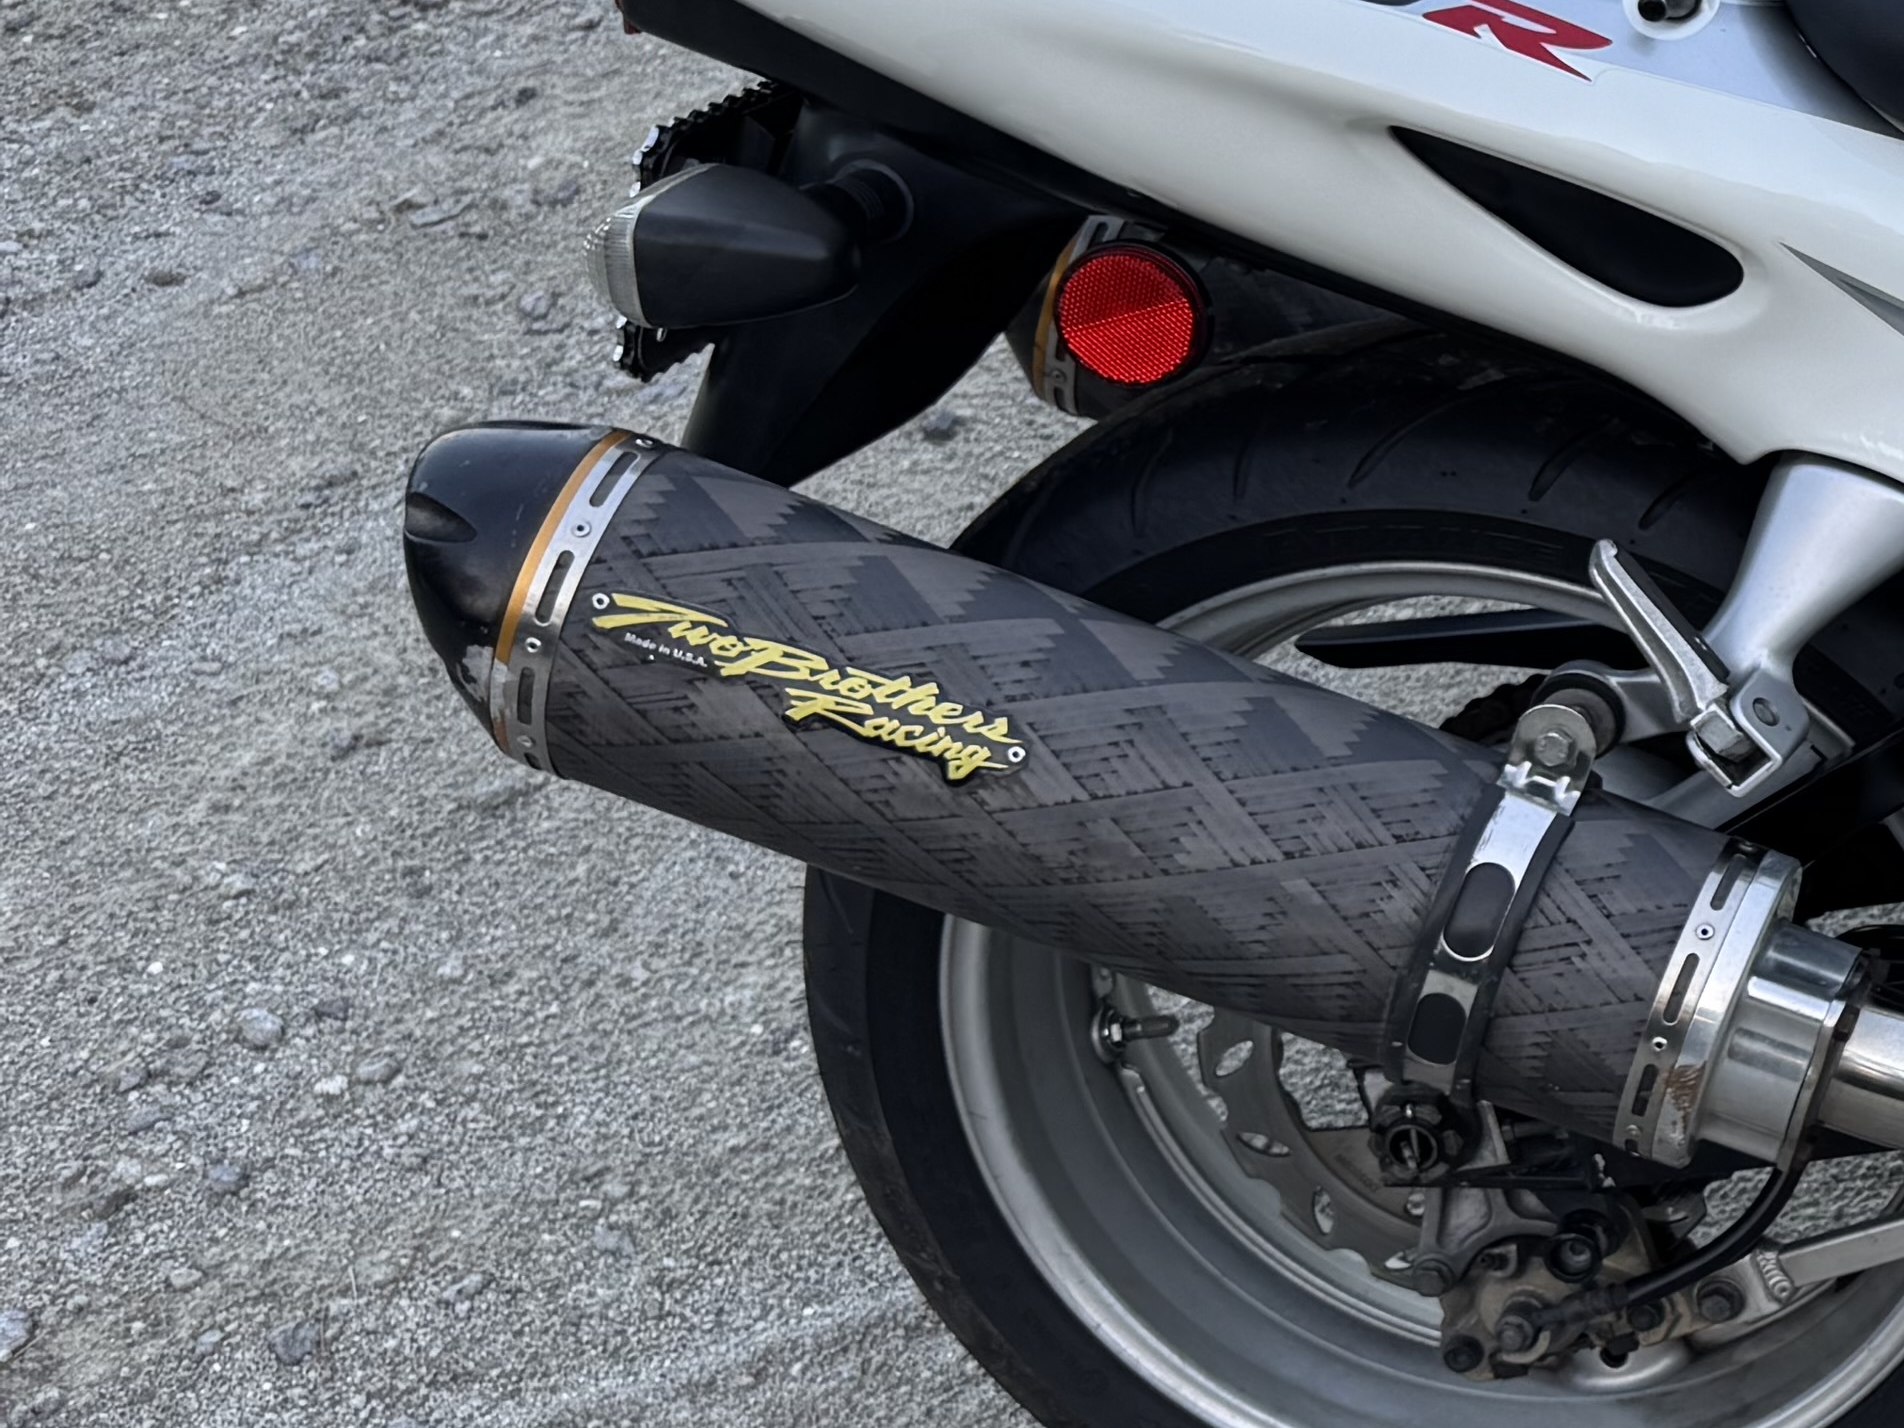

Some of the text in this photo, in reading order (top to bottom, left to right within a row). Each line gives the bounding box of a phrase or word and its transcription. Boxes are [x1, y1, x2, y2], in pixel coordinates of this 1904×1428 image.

[591, 592, 1023, 744] Two Brothers
[624, 632, 657, 650] Made
[783, 687, 1010, 781] Racing
